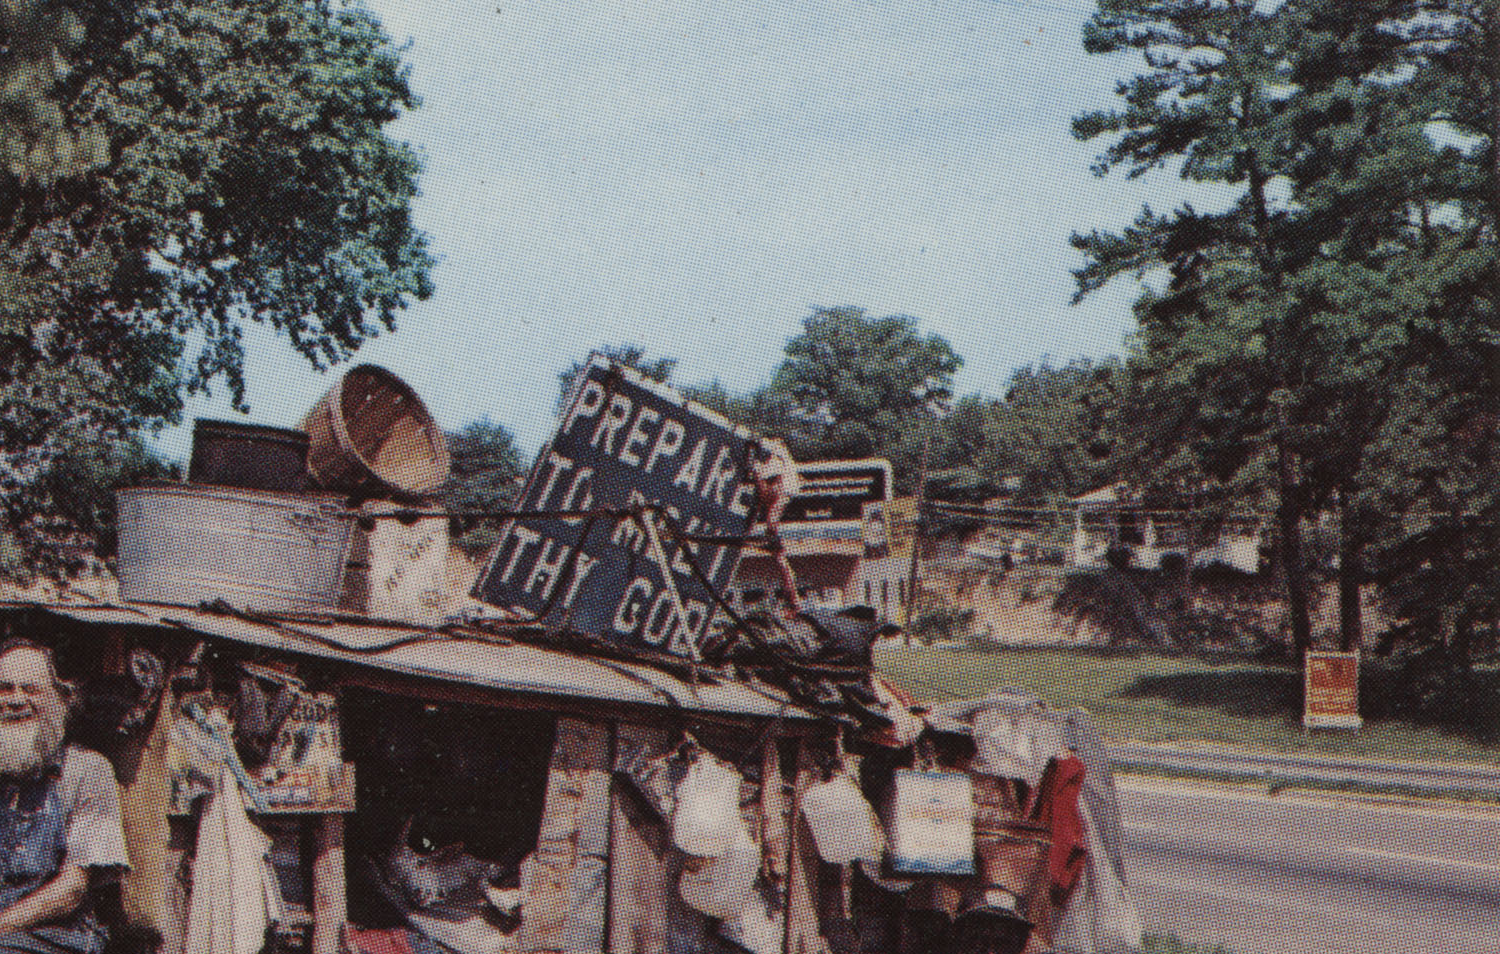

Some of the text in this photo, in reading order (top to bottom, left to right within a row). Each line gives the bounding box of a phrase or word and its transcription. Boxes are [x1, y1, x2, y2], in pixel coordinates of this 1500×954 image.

[536, 452, 595, 525] TO
[500, 525, 600, 610] THY
[613, 576, 710, 657] GOD
